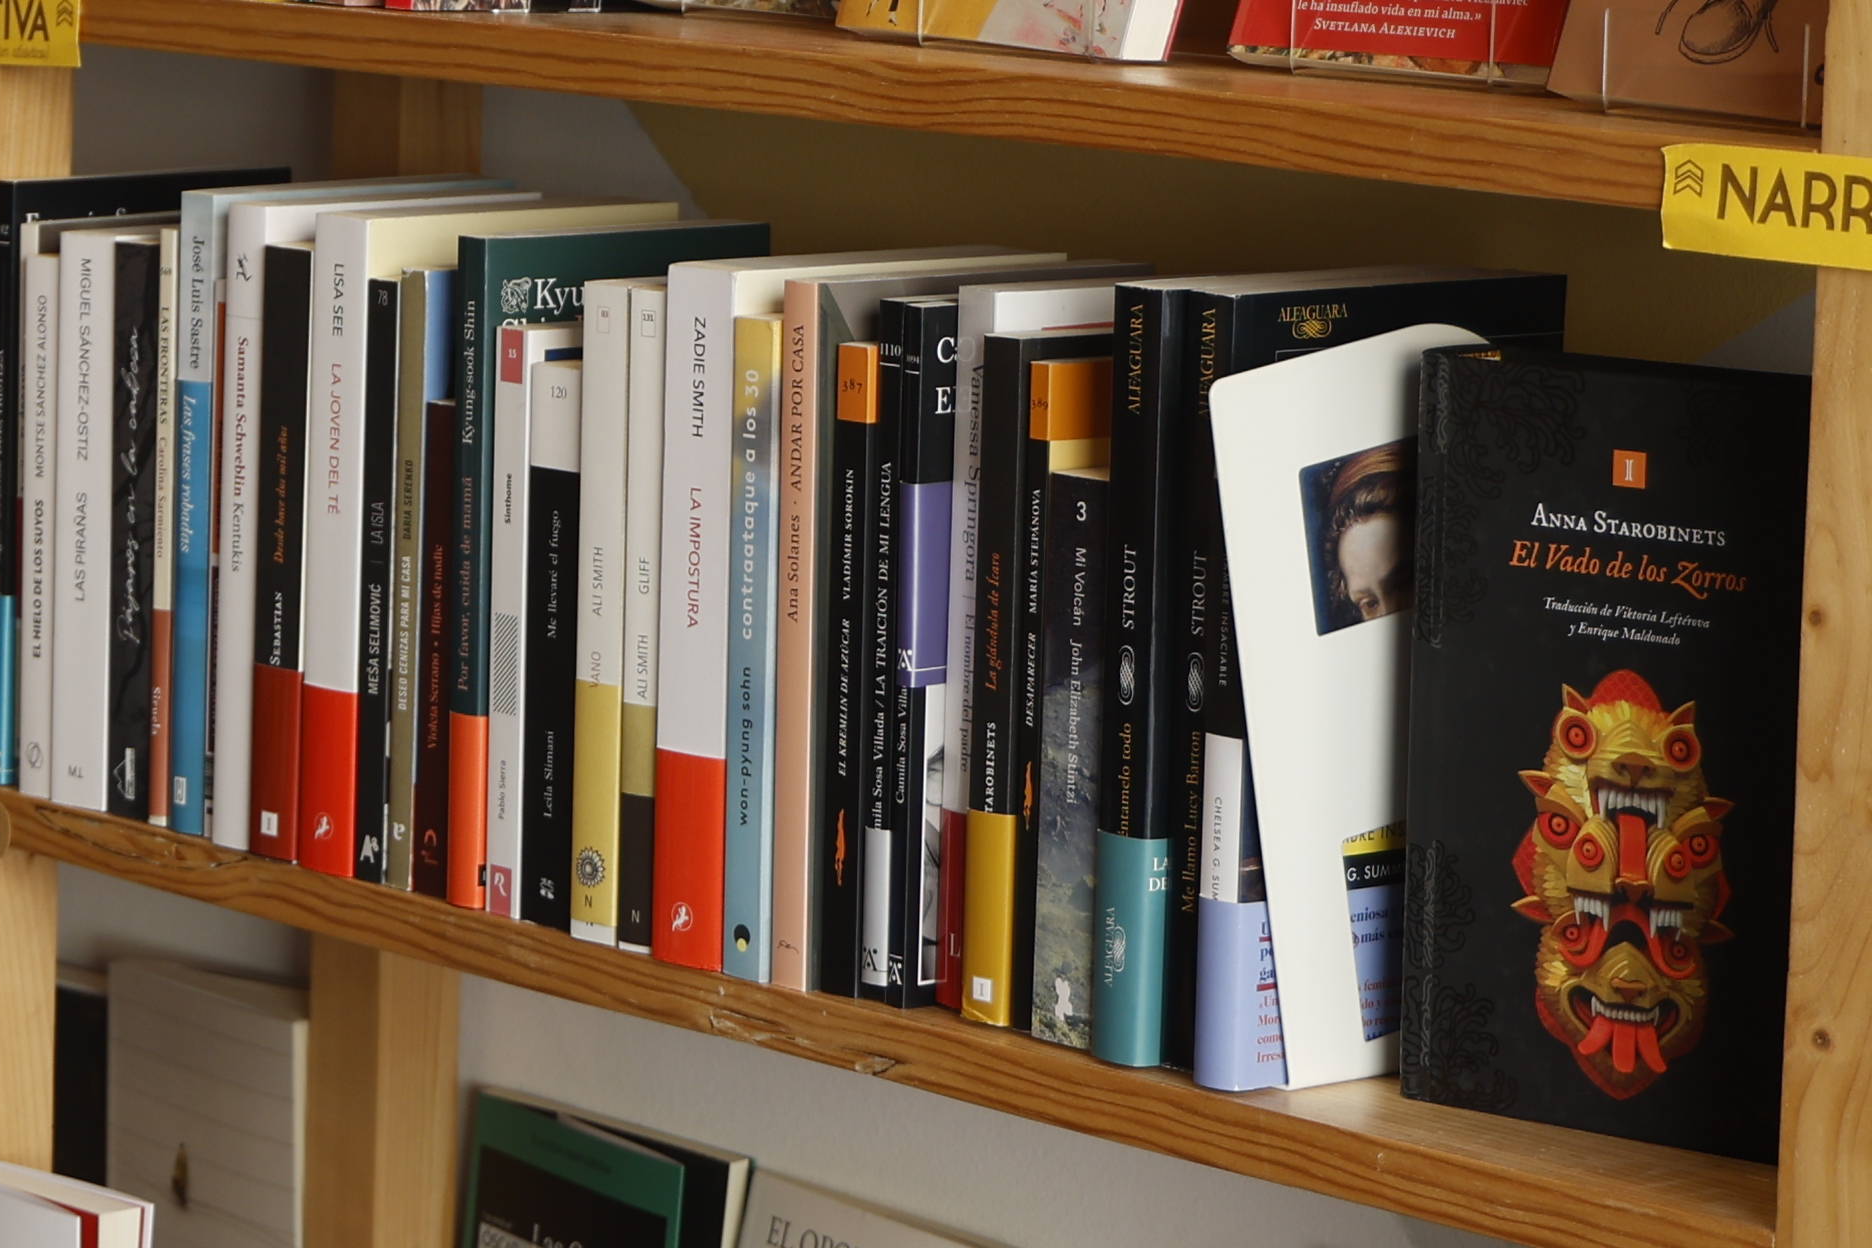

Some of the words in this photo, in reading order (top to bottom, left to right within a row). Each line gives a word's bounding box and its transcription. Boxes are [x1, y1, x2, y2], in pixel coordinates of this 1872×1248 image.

[1313, 18, 1377, 34] SVETLANA
[1378, 22, 1456, 39] ALEXIEVICH
[1716, 162, 1872, 235] NARR
[79, 257, 92, 321] MIGUEL
[332, 263, 344, 300] LISA
[36, 294, 48, 350] ALONSO
[331, 305, 343, 336] SEE
[692, 316, 707, 374] ZADIE
[791, 324, 805, 373] CASA
[1127, 303, 1144, 414] ALFAGUARA
[76, 324, 92, 461] SÁNCHEZ-OSTIZ
[234, 335, 249, 408] Samanta
[331, 363, 342, 385] LA
[744, 368, 760, 398] 30
[691, 379, 706, 438] SMITH
[791, 378, 804, 417] POR
[329, 390, 342, 450] JOVEN
[742, 406, 757, 440] los
[34, 419, 46, 478] MONTSE
[233, 413, 247, 497] Schweblin
[745, 449, 756, 463] a
[790, 422, 803, 492] ANDAR
[328, 456, 340, 489] DEL
[327, 495, 339, 513] TÉ
[689, 487, 701, 510] LA
[33, 499, 45, 543] SUYOS
[74, 492, 87, 564] PIRAÑAS
[231, 503, 245, 572] Kentukis
[1529, 503, 1588, 532] ANNA
[1593, 510, 1727, 547] STAROBINETS
[33, 548, 43, 574] LOS
[740, 471, 757, 640] contraataque
[787, 513, 801, 583] Solanes
[1508, 539, 1538, 569] El
[1545, 543, 1601, 576] Vado
[1605, 552, 1633, 579] de
[1638, 554, 1669, 583] los
[1671, 560, 1748, 600] Zorros
[33, 577, 43, 596] DE
[75, 568, 86, 602] LAS
[638, 556, 650, 595] GLIFF
[687, 517, 702, 628] IMPOSTURA
[1122, 544, 1137, 630] STROUT
[787, 587, 799, 623] Ana
[1542, 596, 1599, 617] Traducción
[1599, 604, 1613, 619] de
[1613, 605, 1658, 626] Viktoria
[1659, 608, 1711, 630] Leftérova
[32, 645, 42, 659] EL
[637, 634, 649, 676] SMITH
[1568, 623, 1577, 638] y
[1577, 621, 1620, 641] Enrique
[1621, 625, 1681, 647] Maldonado
[636, 677, 648, 700] ALI
[739, 666, 752, 711] sohn
[738, 717, 753, 826] won-pyung
